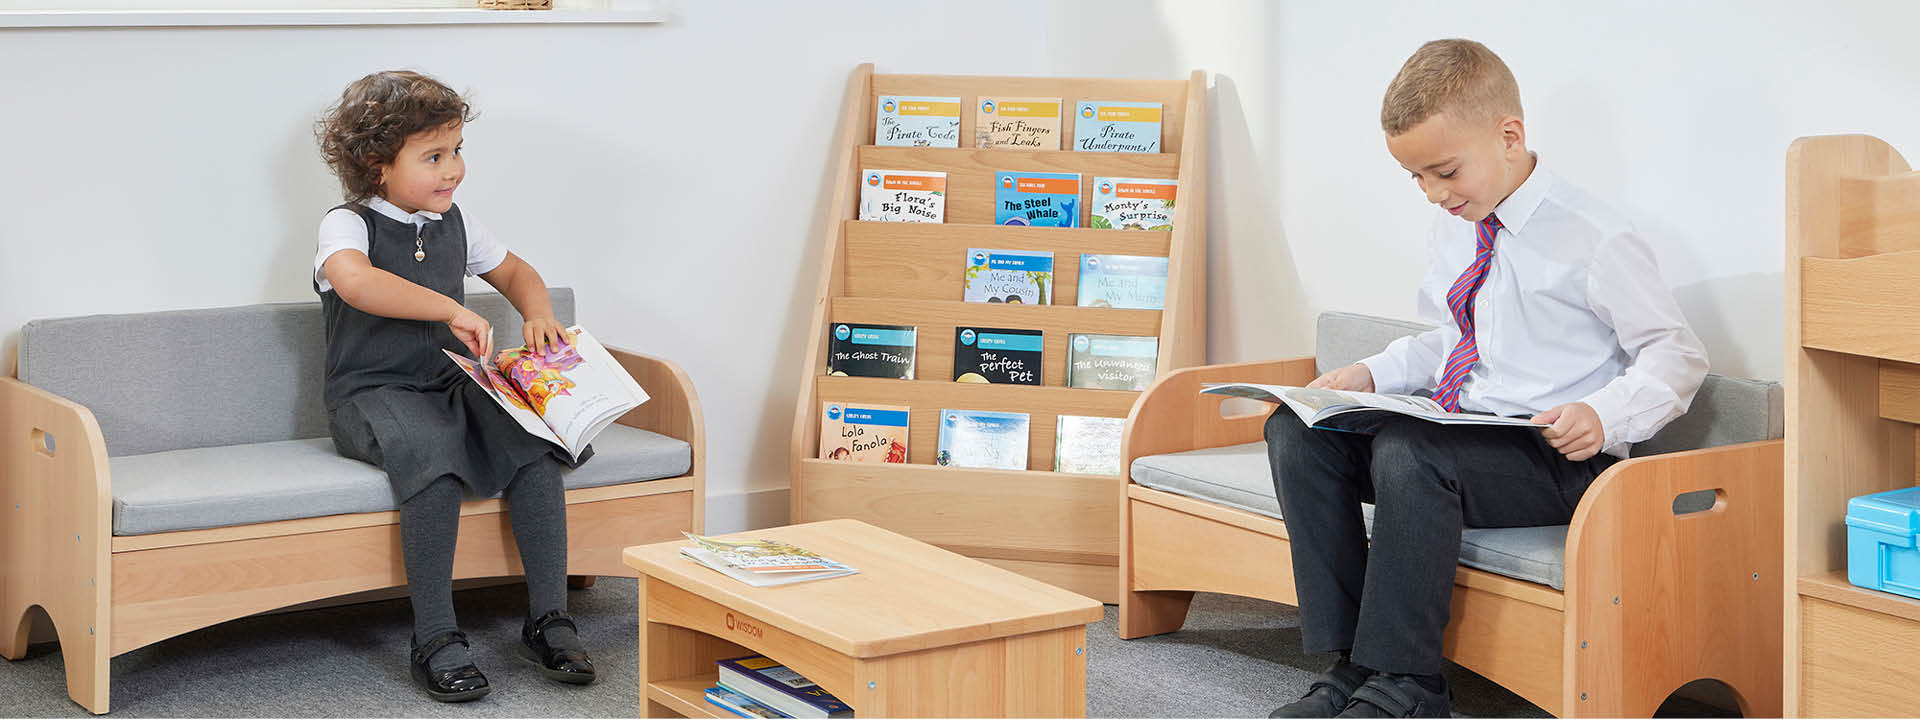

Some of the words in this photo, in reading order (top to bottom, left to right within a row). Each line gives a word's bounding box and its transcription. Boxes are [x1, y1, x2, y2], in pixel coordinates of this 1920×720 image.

[881, 116, 896, 126] The
[990, 120, 1013, 134] Fish
[1015, 120, 1051, 135] Fingers
[886, 124, 922, 141] Pirate
[926, 125, 956, 140] Code
[1099, 123, 1135, 140] Pirate
[995, 136, 1010, 146] and
[1010, 133, 1042, 148] Leaks
[1080, 137, 1156, 152] Underpants!
[895, 191, 936, 209] Flora's
[1004, 200, 1023, 211] The
[1025, 197, 1051, 209] Steel
[1104, 200, 1149, 213] Monty's
[882, 202, 901, 215] Big
[908, 204, 937, 220] Noise
[1026, 208, 1059, 221] Whale
[1119, 210, 1168, 222] Surprise
[990, 272, 1006, 282] Me
[1007, 273, 1025, 283] and
[984, 283, 1000, 296] My
[1002, 283, 1034, 298] Cousin
[835, 351, 850, 361] The
[851, 351, 879, 361] Ghost
[880, 352, 911, 365] Train
[980, 351, 997, 362] The
[979, 357, 1025, 373] Perfect
[1074, 360, 1091, 371] The
[1008, 370, 1034, 383] Pet
[841, 424, 865, 438] Lola
[851, 434, 888, 453] Fanola
[735, 619, 764, 639] WISDOM
